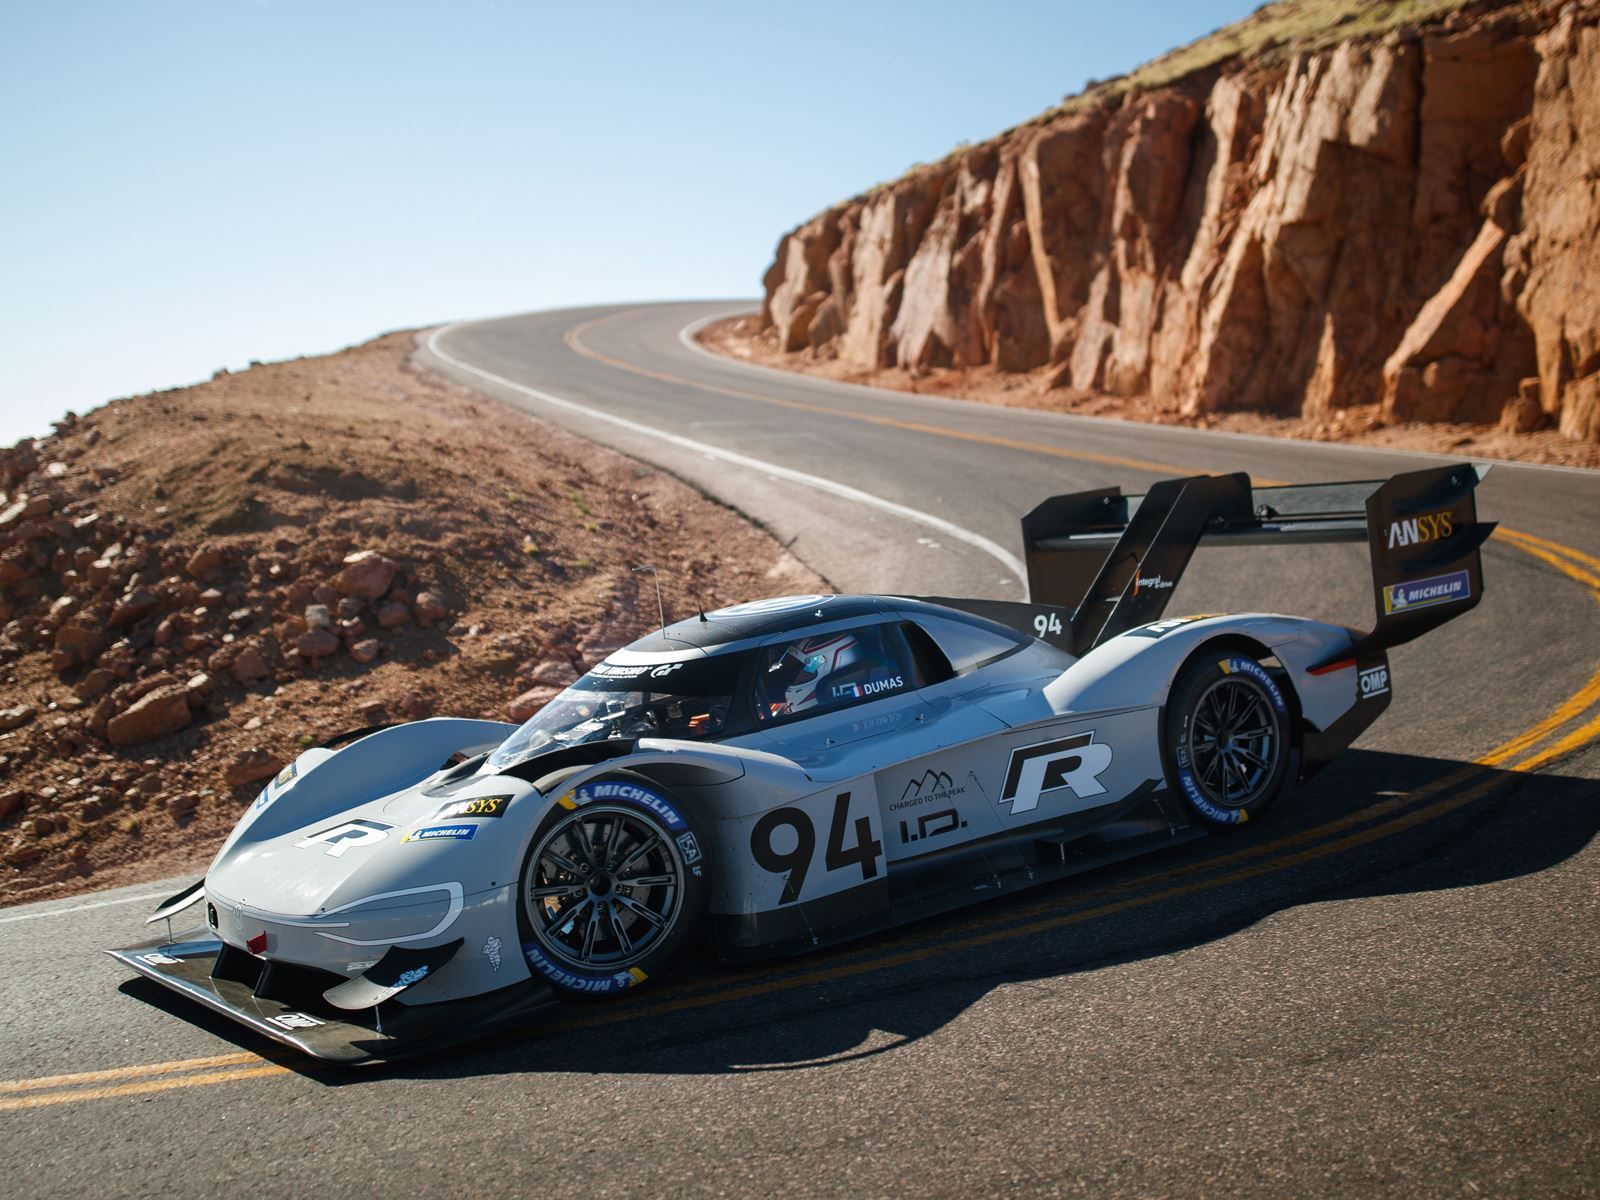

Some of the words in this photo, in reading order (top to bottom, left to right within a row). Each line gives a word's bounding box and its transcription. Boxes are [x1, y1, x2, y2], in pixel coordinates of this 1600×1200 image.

[1388, 511, 1453, 549] ANSYS
[1408, 580, 1462, 601] MICHELIN
[1034, 612, 1062, 638] 94
[864, 676, 903, 695] DUMAS
[1240, 660, 1284, 707] MICHELIN
[1360, 670, 1388, 693] OMP
[998, 729, 1113, 816] R
[593, 783, 679, 825] MICHELIN
[889, 797, 922, 812] CHARGED
[924, 795, 933, 803] TO
[949, 786, 966, 796] PEAK
[1183, 776, 1230, 822] MICHELIN
[294, 819, 398, 857] R
[421, 829, 470, 838] MICHELIN
[899, 808, 968, 844] I.D.
[750, 792, 883, 905] 94
[526, 949, 612, 992] MICHELIN
